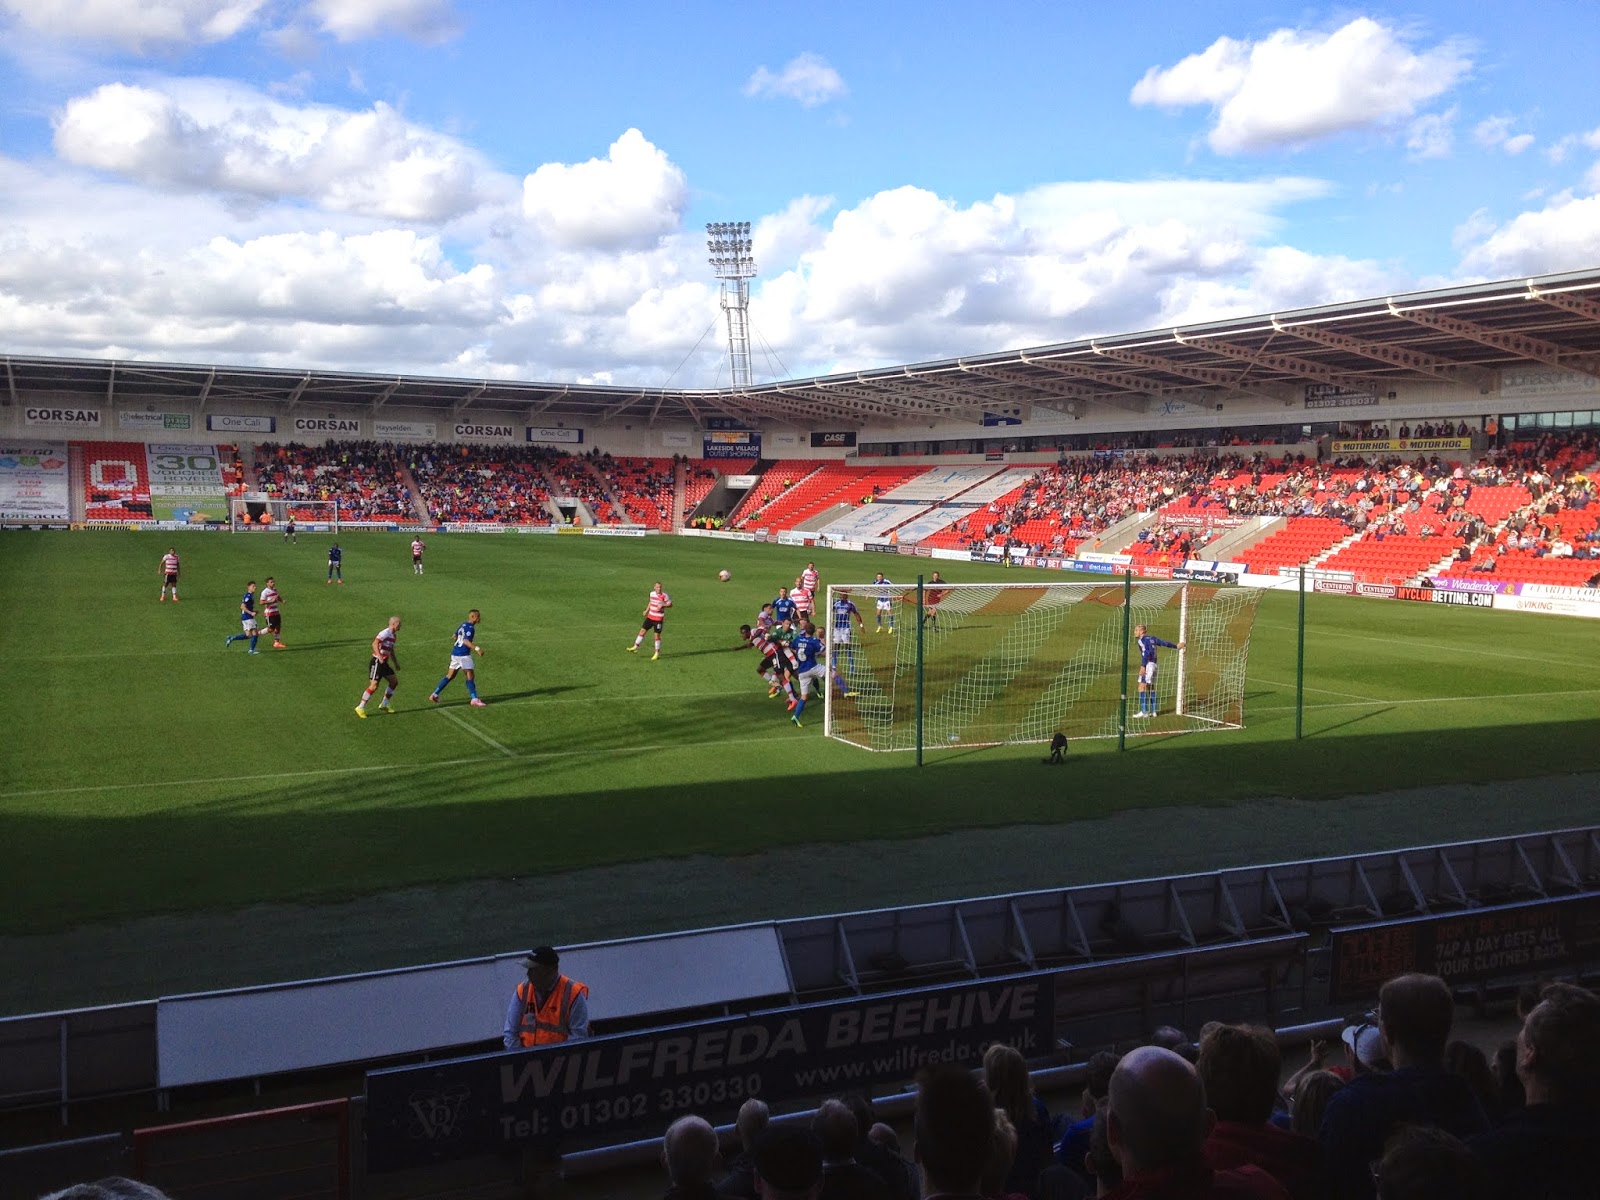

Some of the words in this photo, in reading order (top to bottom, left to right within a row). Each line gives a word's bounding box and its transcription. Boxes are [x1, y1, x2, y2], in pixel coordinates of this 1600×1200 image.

[1307, 400, 1336, 408] 01302
[27, 408, 98, 421] CORSAN
[222, 417, 241, 426] One
[244, 417, 261, 426] Call
[296, 419, 359, 431] CORSAN
[455, 425, 512, 436] CORSAN
[824, 434, 845, 442] CASE
[1014, 556, 1023, 565] sky
[1024, 558, 1035, 566] BET
[1037, 558, 1046, 567] sky
[1048, 559, 1060, 568] BET
[1363, 586, 1394, 594] CENTURION
[1524, 600, 1553, 610] VIKING
[797, 648, 807, 662] 6
[1475, 935, 1501, 952] DAY
[1504, 930, 1536, 948] GETS
[1540, 926, 1562, 942] ALL
[1435, 959, 1471, 976] YOUR
[1474, 948, 1530, 970] CLOTHES
[500, 1018, 807, 1104] WILFREDA
[825, 983, 1040, 1049] BEEHIVE
[500, 1108, 549, 1139] Tel:
[560, 1092, 647, 1128] 01302
[658, 1072, 762, 1111] 330330
